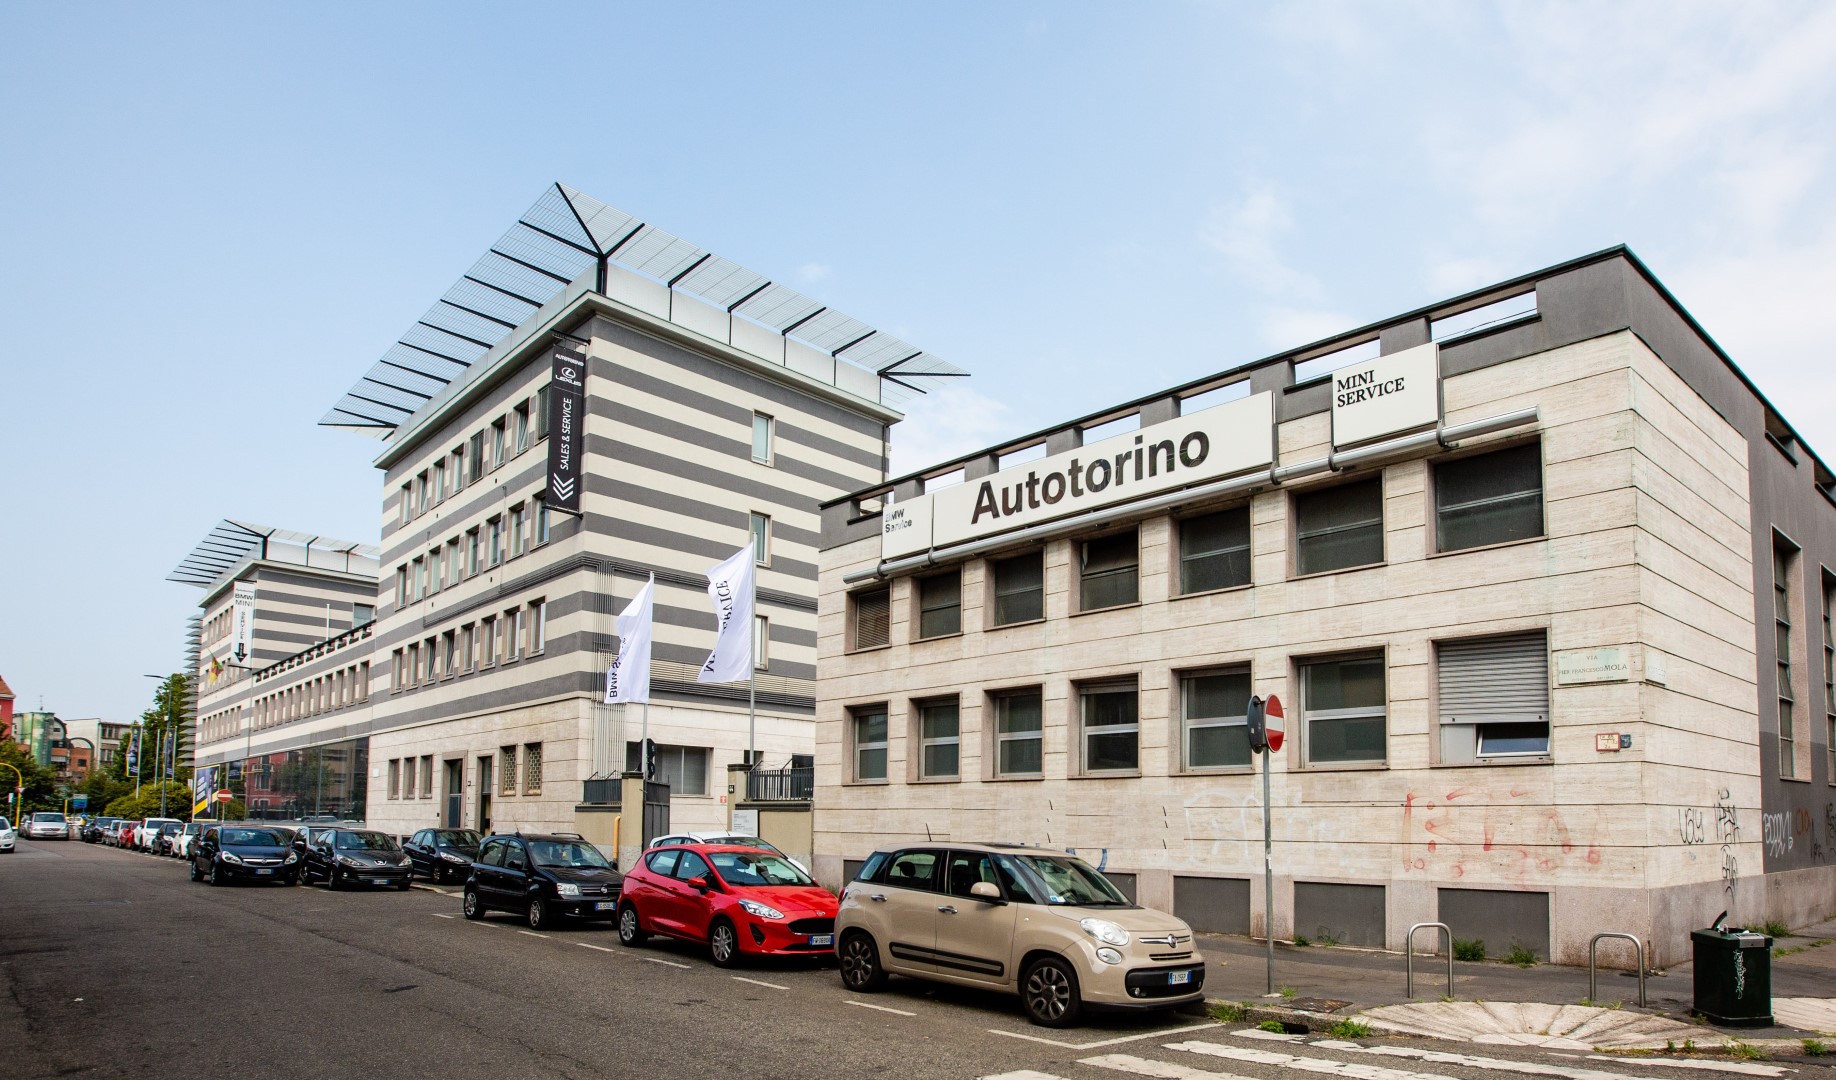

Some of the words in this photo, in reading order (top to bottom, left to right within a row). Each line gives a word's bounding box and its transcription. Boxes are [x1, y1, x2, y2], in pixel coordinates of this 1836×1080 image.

[555, 374, 582, 387] LEXUS
[1337, 369, 1375, 393] MINI
[1337, 377, 1405, 408] SERVICE
[561, 397, 572, 435] SERVICE
[560, 443, 570, 470] SALES
[971, 430, 1210, 525] Autotorino
[885, 508, 905, 523] BMW
[885, 519, 912, 533] Service
[234, 593, 254, 601] BMW
[1604, 663, 1628, 671] MOLA
